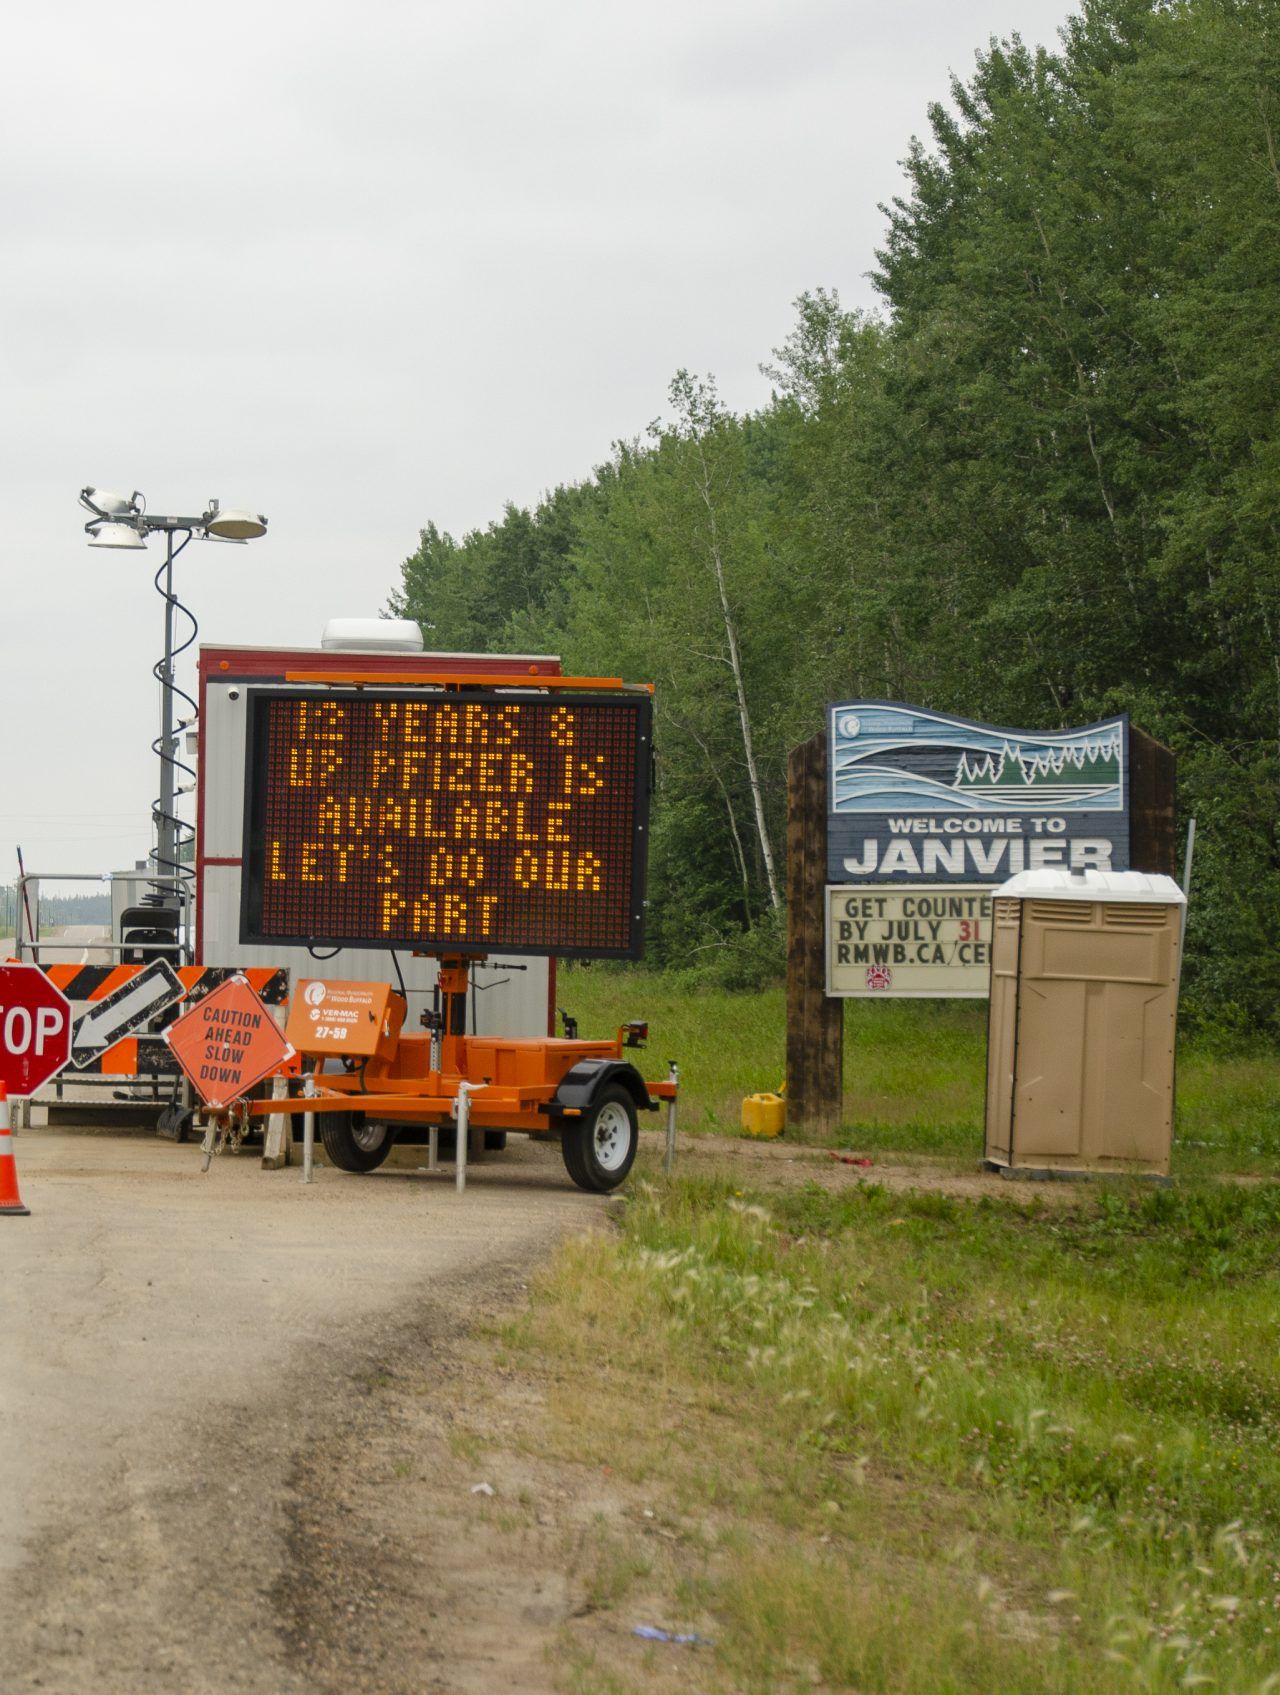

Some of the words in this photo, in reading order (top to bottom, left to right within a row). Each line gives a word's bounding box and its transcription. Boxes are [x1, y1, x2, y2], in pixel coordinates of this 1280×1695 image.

[298, 701, 344, 740] 12
[375, 703, 520, 745] YEARS
[550, 706, 575, 746] &
[290, 748, 343, 787] UP
[372, 749, 534, 793] PFIZER
[564, 754, 604, 795] IS
[318, 795, 571, 842] AVAILABLE
[888, 817, 1023, 833] WELCOME
[1030, 817, 1066, 833] TO
[271, 841, 400, 884] LET'S
[430, 846, 484, 887] DO
[514, 849, 601, 891] OUR
[843, 837, 1113, 874] JANVIER
[382, 891, 498, 935] PART
[845, 897, 887, 918] GET
[839, 920, 868, 941] BY
[881, 920, 942, 941] JULY
[958, 920, 980, 941] 31
[837, 942, 992, 965] RMWB.CA/CE
[203, 1006, 261, 1028] CAUTION
[205, 1026, 252, 1046] AHEAD
[205, 1045, 244, 1064] SLOW
[200, 1064, 241, 1084] DOWN
